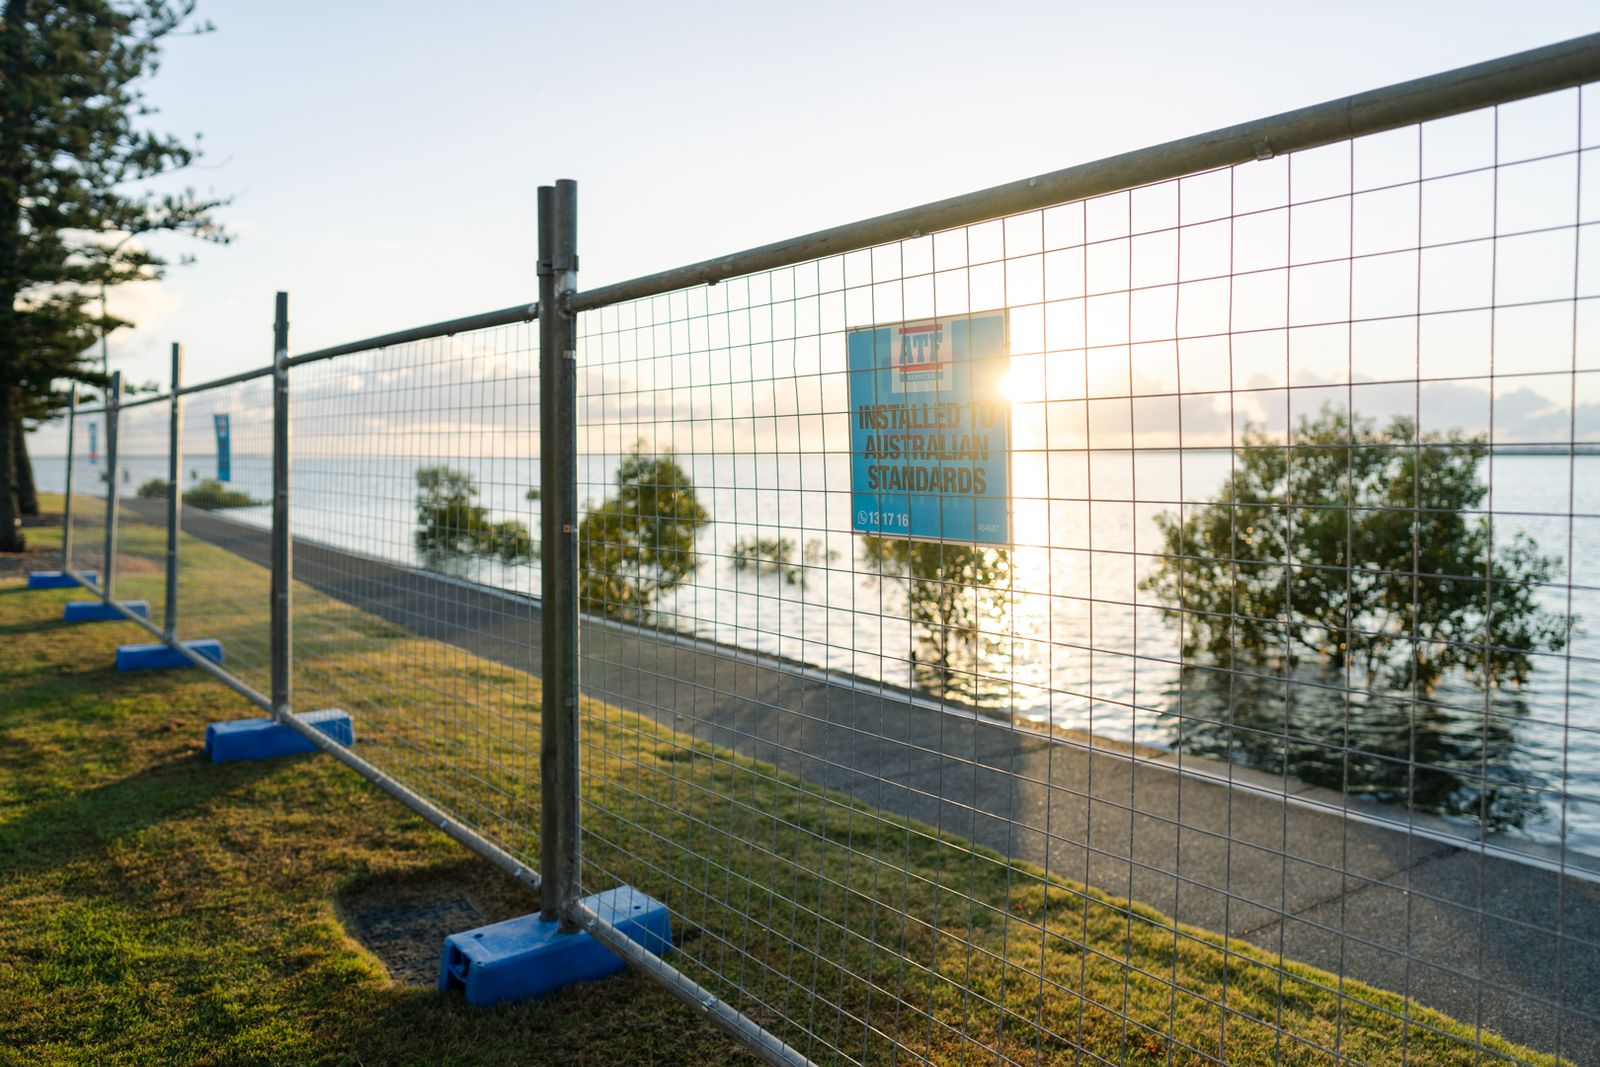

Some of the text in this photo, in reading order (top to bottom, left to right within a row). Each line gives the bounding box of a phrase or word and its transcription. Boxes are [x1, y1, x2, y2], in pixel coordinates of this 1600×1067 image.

[899, 332, 943, 364] ATF
[859, 402, 960, 430] INSTALLED
[864, 433, 989, 461] AUSTRALIAN
[867, 465, 987, 494] STANDARDS
[868, 511, 909, 527] 13 17 16
